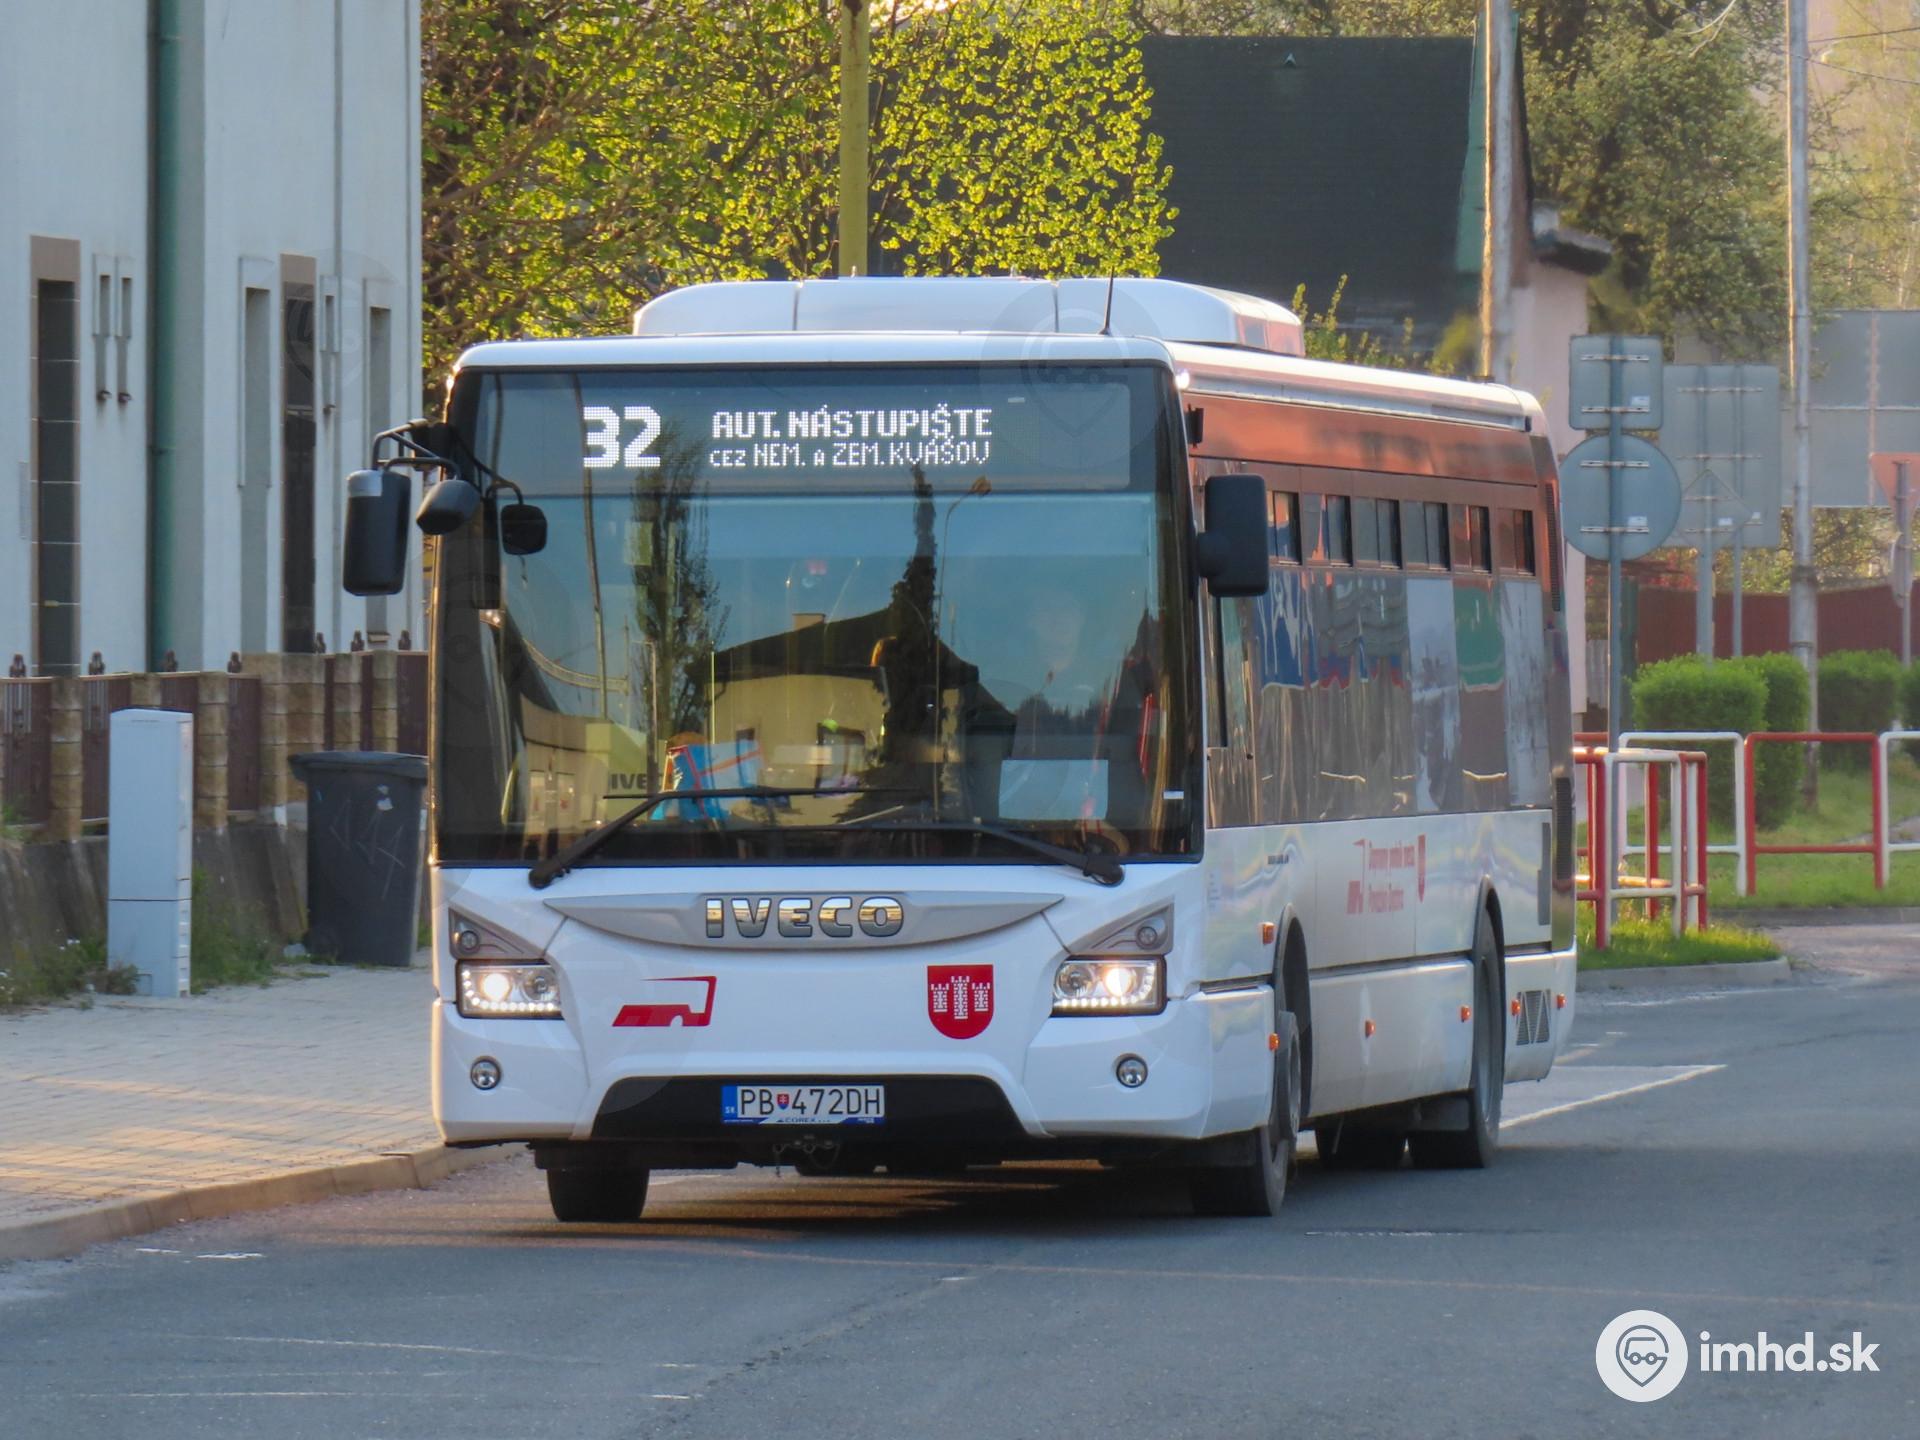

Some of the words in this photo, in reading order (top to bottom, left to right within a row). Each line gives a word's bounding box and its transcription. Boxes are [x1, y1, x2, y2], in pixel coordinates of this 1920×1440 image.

[583, 406, 661, 468] 32
[753, 442, 806, 467] NEM.
[705, 896, 904, 938] IVECO
